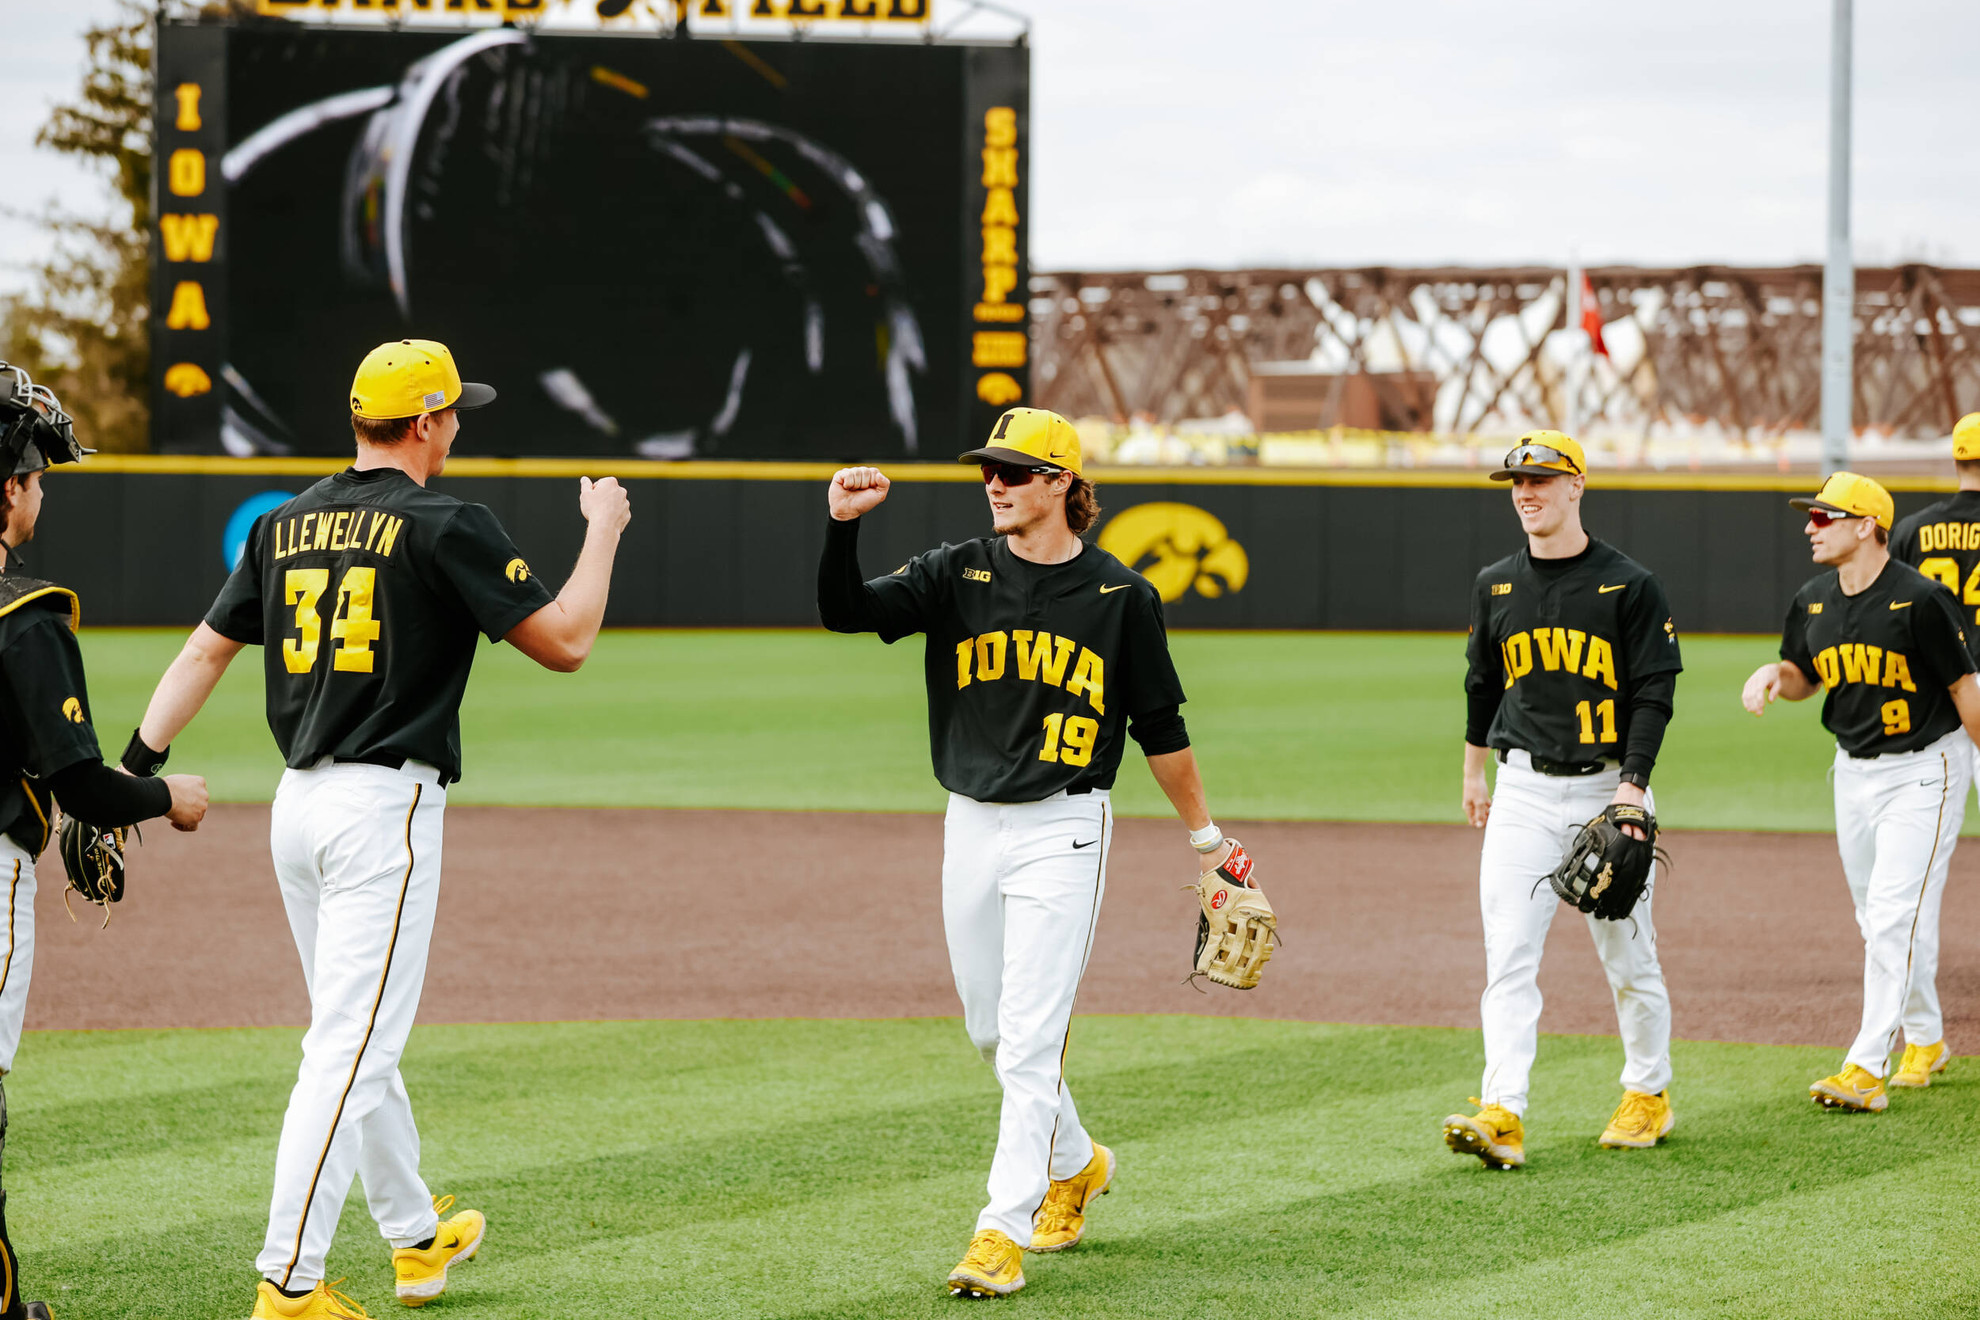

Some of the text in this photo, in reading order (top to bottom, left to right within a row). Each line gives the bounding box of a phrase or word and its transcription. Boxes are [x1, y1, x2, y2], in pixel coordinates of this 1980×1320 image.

[159, 82, 219, 330] IOWA
[993, 414, 1015, 439] I
[274, 510, 404, 560] LLEWELLYN
[282, 566, 380, 674] 34
[955, 630, 1106, 717] IOWA
[1038, 712, 1099, 768] 19
[1575, 698, 1618, 744] 11
[1881, 698, 1911, 736] 9
